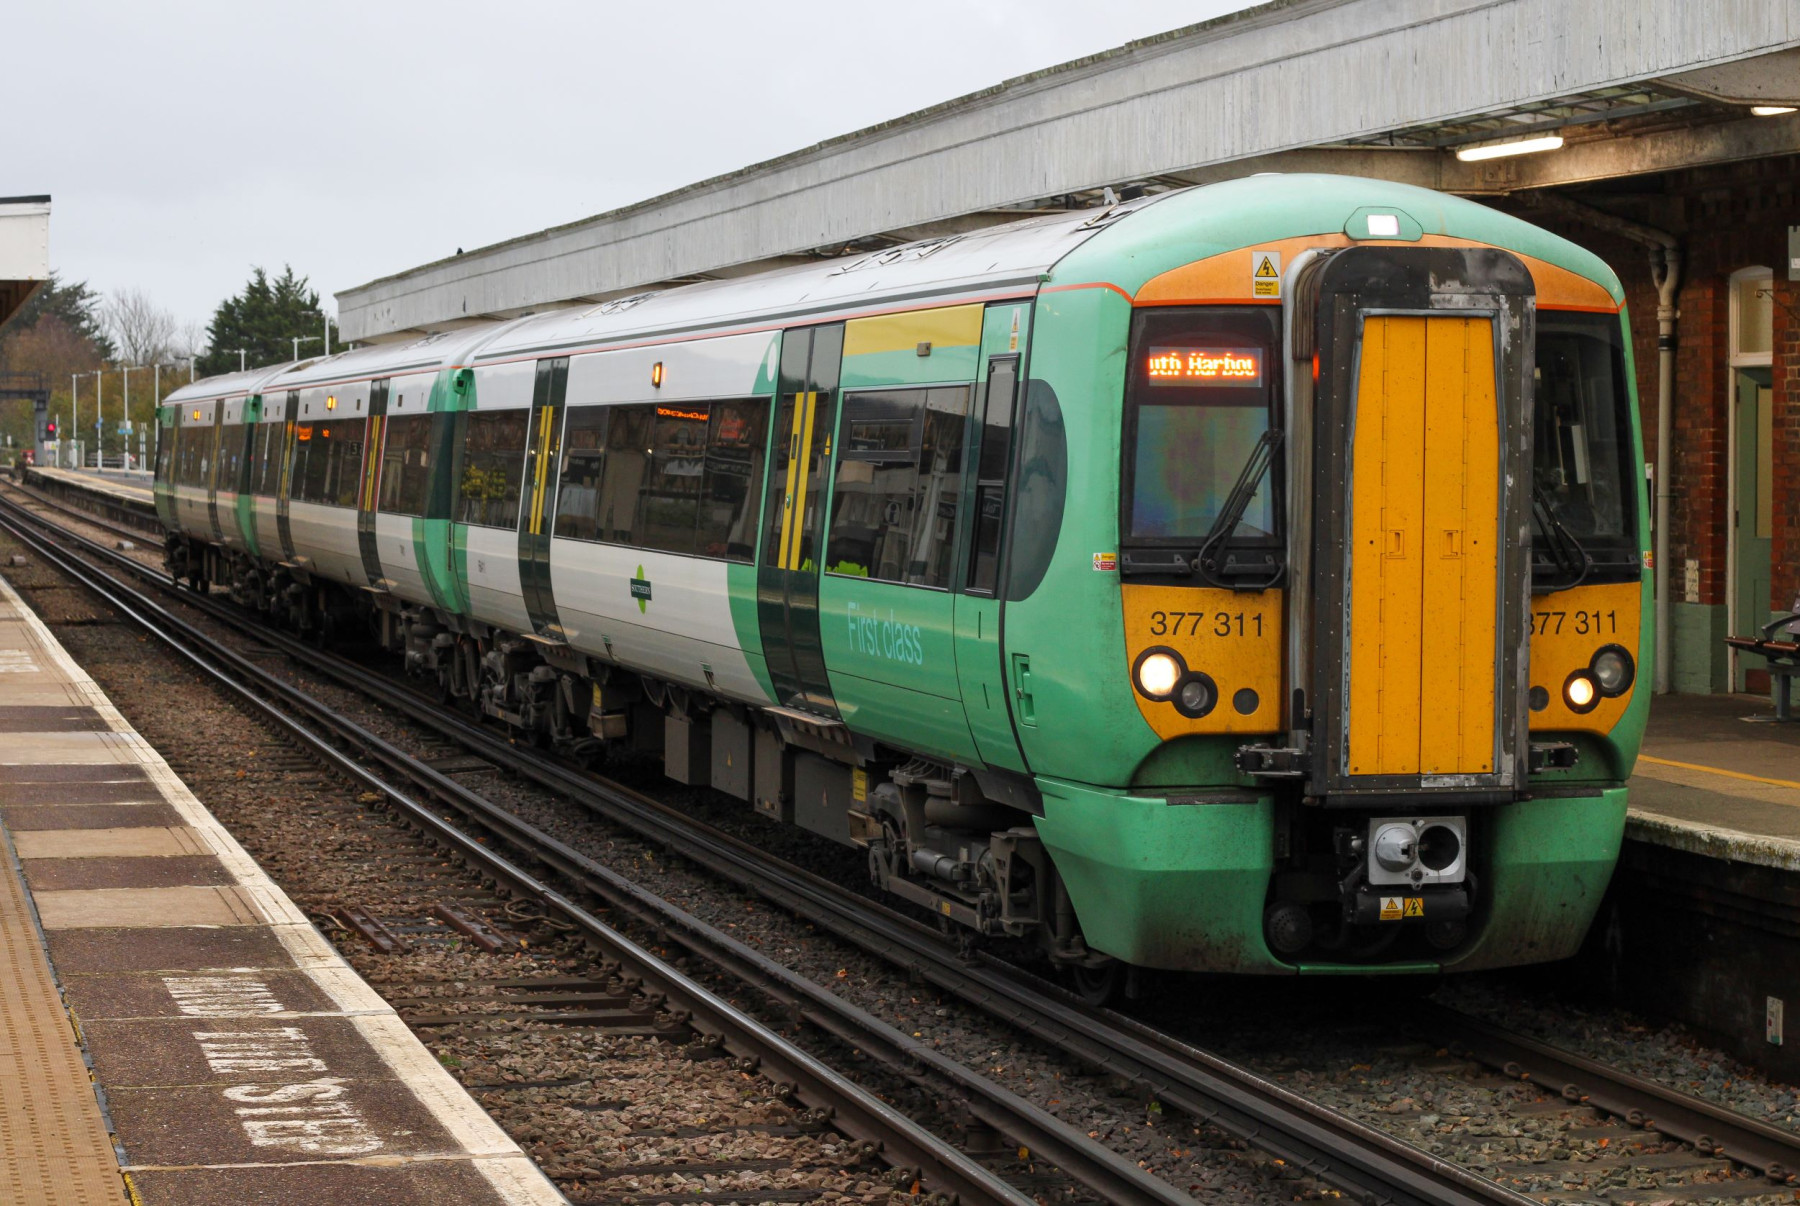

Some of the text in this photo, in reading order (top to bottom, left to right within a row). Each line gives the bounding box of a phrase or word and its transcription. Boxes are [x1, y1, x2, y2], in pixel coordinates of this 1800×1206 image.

[848, 601, 923, 666] First class
[1150, 611, 1262, 637] 377 311
[1575, 610, 1616, 635] 311
[162, 977, 384, 1153] MIND THE STEP
